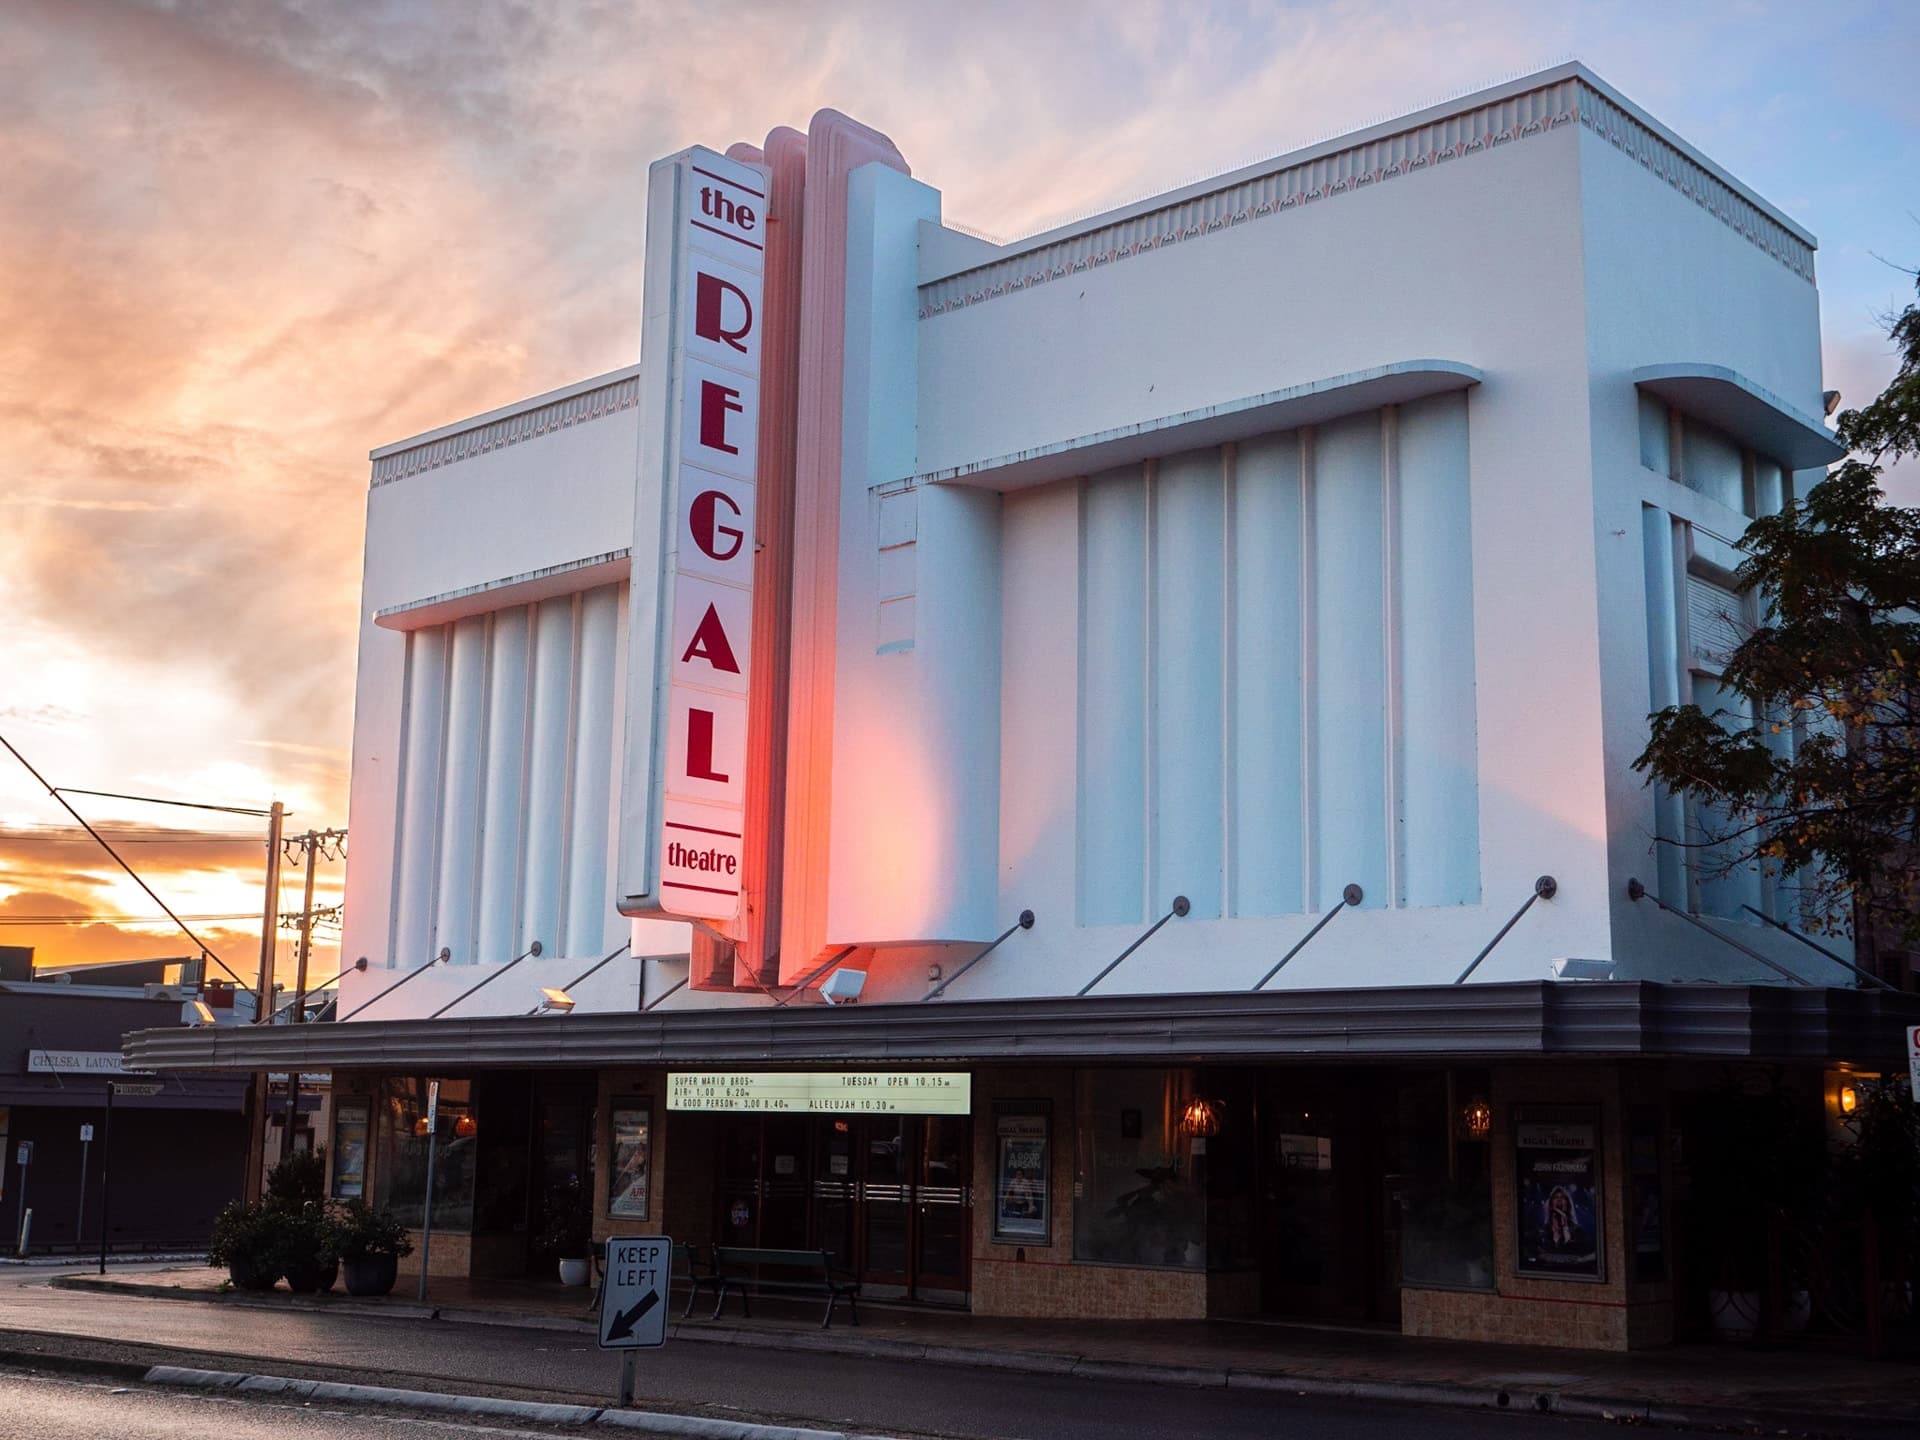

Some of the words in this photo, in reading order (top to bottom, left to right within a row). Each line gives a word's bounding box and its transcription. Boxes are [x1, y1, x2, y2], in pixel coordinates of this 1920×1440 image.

[700, 186, 756, 231] the
[681, 271, 753, 784] REGAL
[668, 842, 737, 876] theatre
[33, 1055, 80, 1068] CHELSEA
[86, 1056, 121, 1069] LAUND
[675, 1077, 697, 1085] SUPER
[702, 1077, 725, 1085] MARIO
[842, 1077, 878, 1086] TUESDAY
[888, 1077, 908, 1086] OPEN
[916, 1077, 942, 1087] 10.15
[697, 1088, 715, 1097] 1.00
[683, 1099, 701, 1107] GOOD
[809, 1100, 855, 1109] ALLELUJAH
[861, 1101, 887, 1110] 10.30
[617, 1247, 660, 1264] KEEP
[617, 1270, 657, 1286] LEFT
